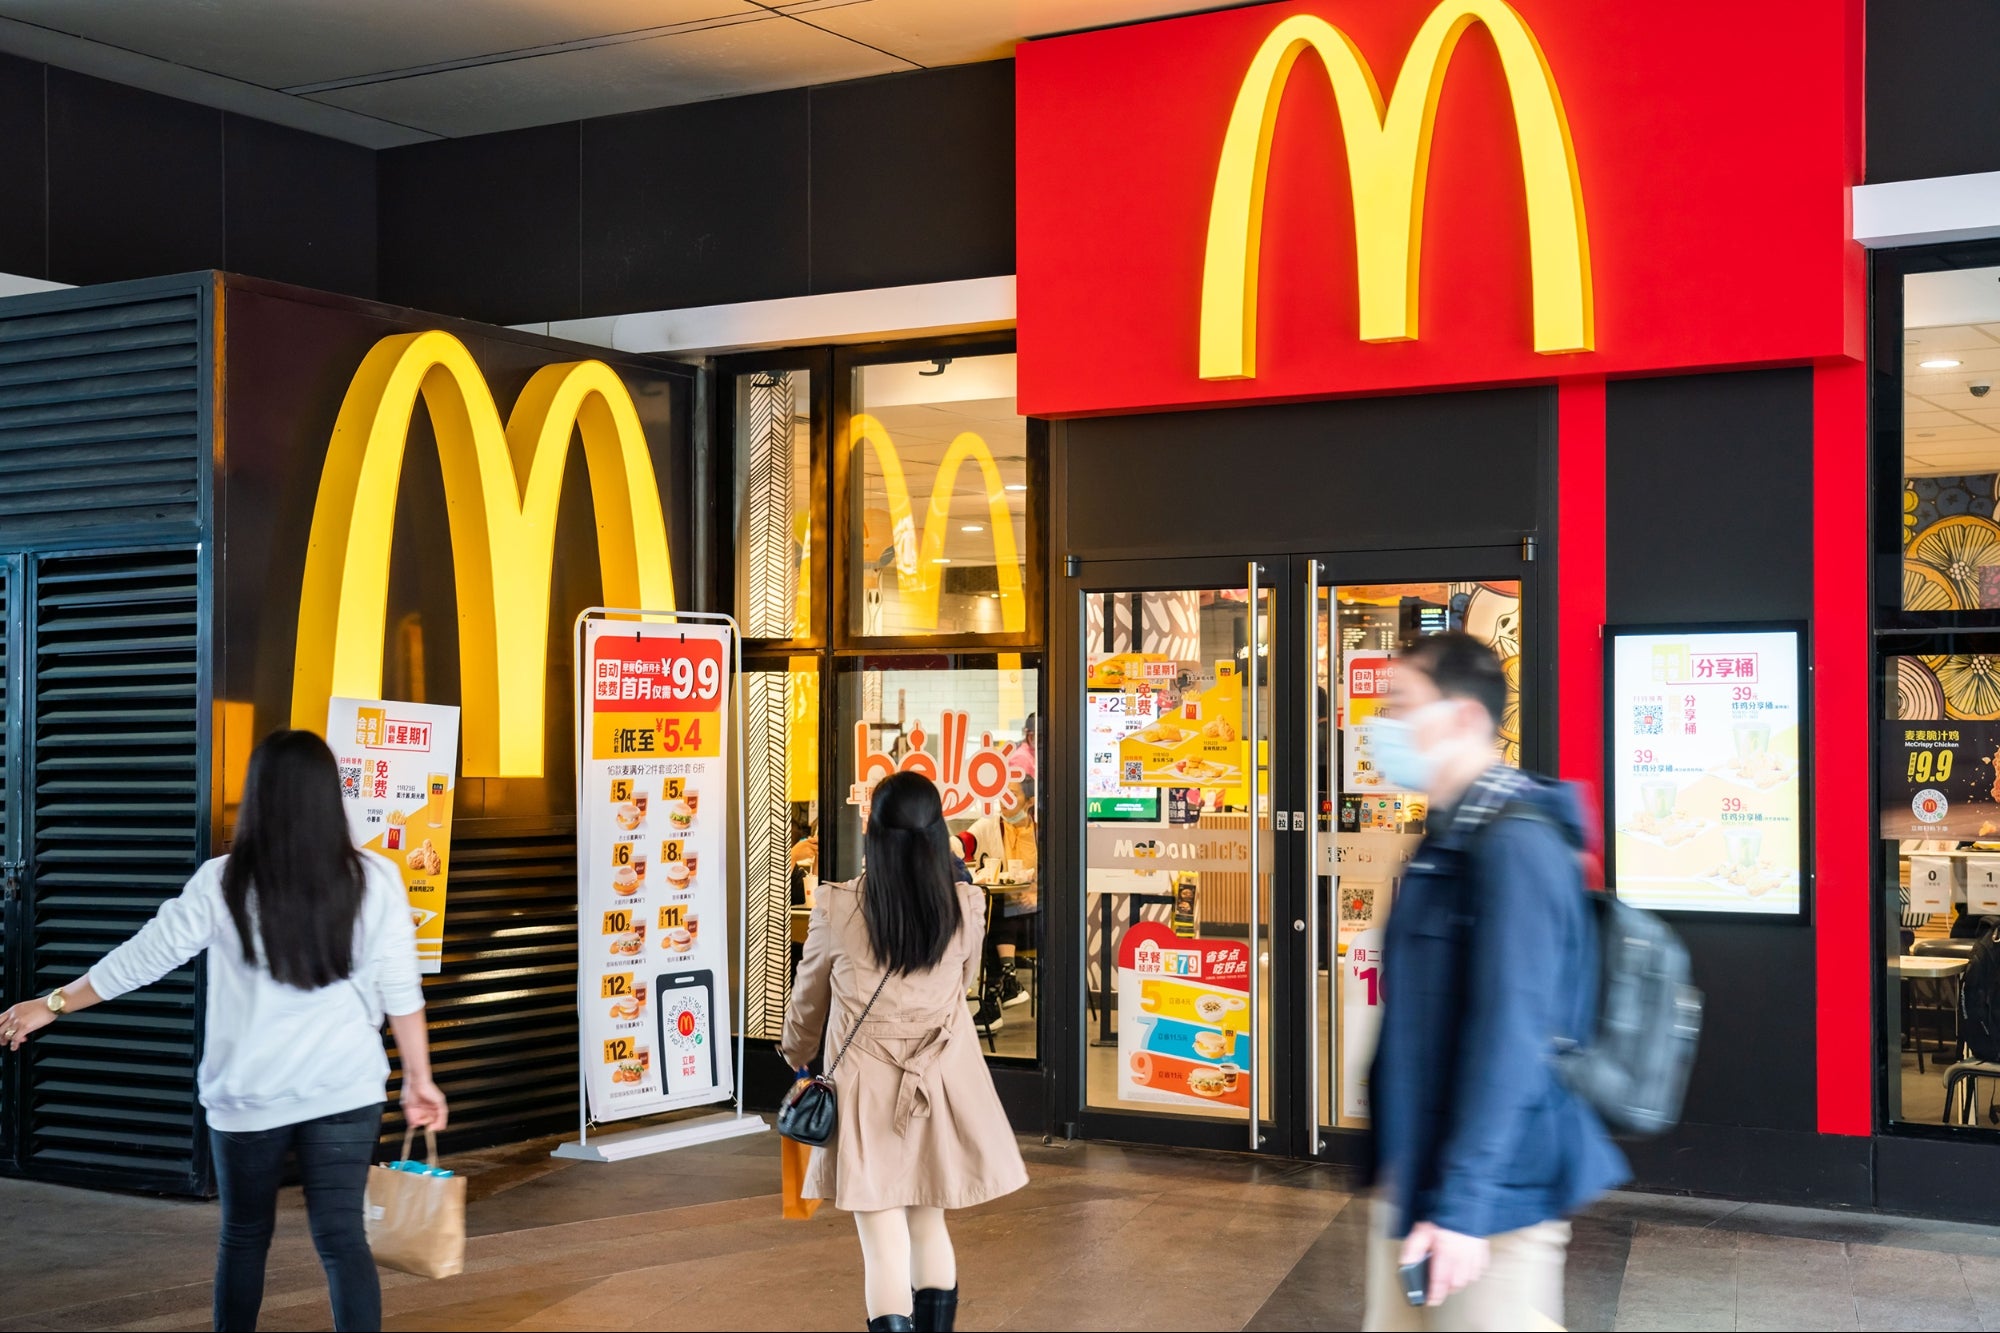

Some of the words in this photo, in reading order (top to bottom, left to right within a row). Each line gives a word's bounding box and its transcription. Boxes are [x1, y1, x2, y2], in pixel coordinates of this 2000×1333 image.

[598, 663, 618, 678] 自动
[1696, 658, 1754, 678] 分享桶
[598, 681, 618, 696] 续费
[1137, 683, 1152, 715] 免费
[1684, 695, 1697, 735] 分享桶
[396, 725, 428, 746] 星期1
[620, 728, 655, 753] 低至
[656, 718, 702, 752] ¥5.4
[1905, 730, 1960, 741] 麦麦脆汁鸡
[857, 712, 1018, 802] hello
[374, 760, 389, 799] 免费
[1278, 819, 1287, 829] 拉
[1294, 820, 1303, 829] 拉
[619, 845, 629, 864] 6
[667, 842, 681, 861] 8.1
[1113, 839, 1247, 860] McDonald's
[608, 912, 630, 932] 10.2
[1138, 952, 1161, 963] 早餐
[1205, 949, 1240, 963] 省多点
[1212, 961, 1247, 975] 吃好点
[608, 976, 632, 995] 12.3
[1140, 980, 1162, 1013] 5
[1136, 1016, 1158, 1049] 7
[682, 1055, 696, 1065] 立即
[1129, 1051, 1153, 1085] 9
[682, 1066, 696, 1076] 购买
